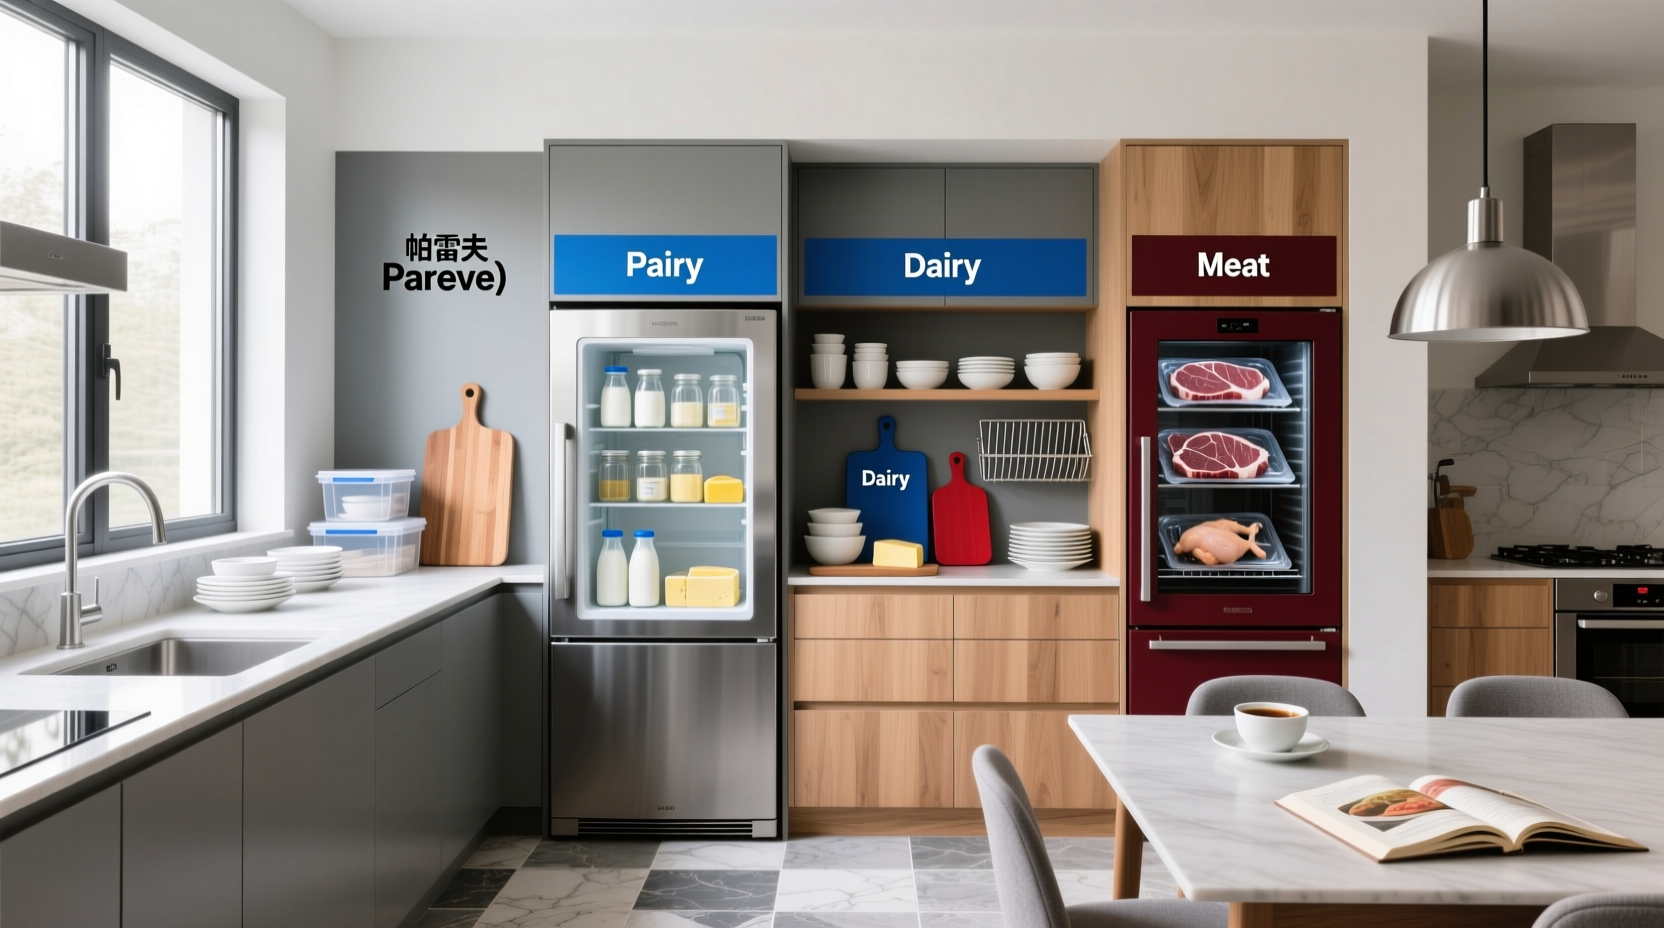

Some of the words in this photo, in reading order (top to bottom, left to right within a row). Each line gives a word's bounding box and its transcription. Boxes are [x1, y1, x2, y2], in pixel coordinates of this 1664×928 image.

[405, 233, 489, 262] 帕雷夫
[383, 260, 506, 296] Pareve)
[626, 251, 704, 285] Pairy
[904, 252, 982, 286] Dairy
[1198, 252, 1270, 277] Meat
[862, 469, 911, 491] Dairy
